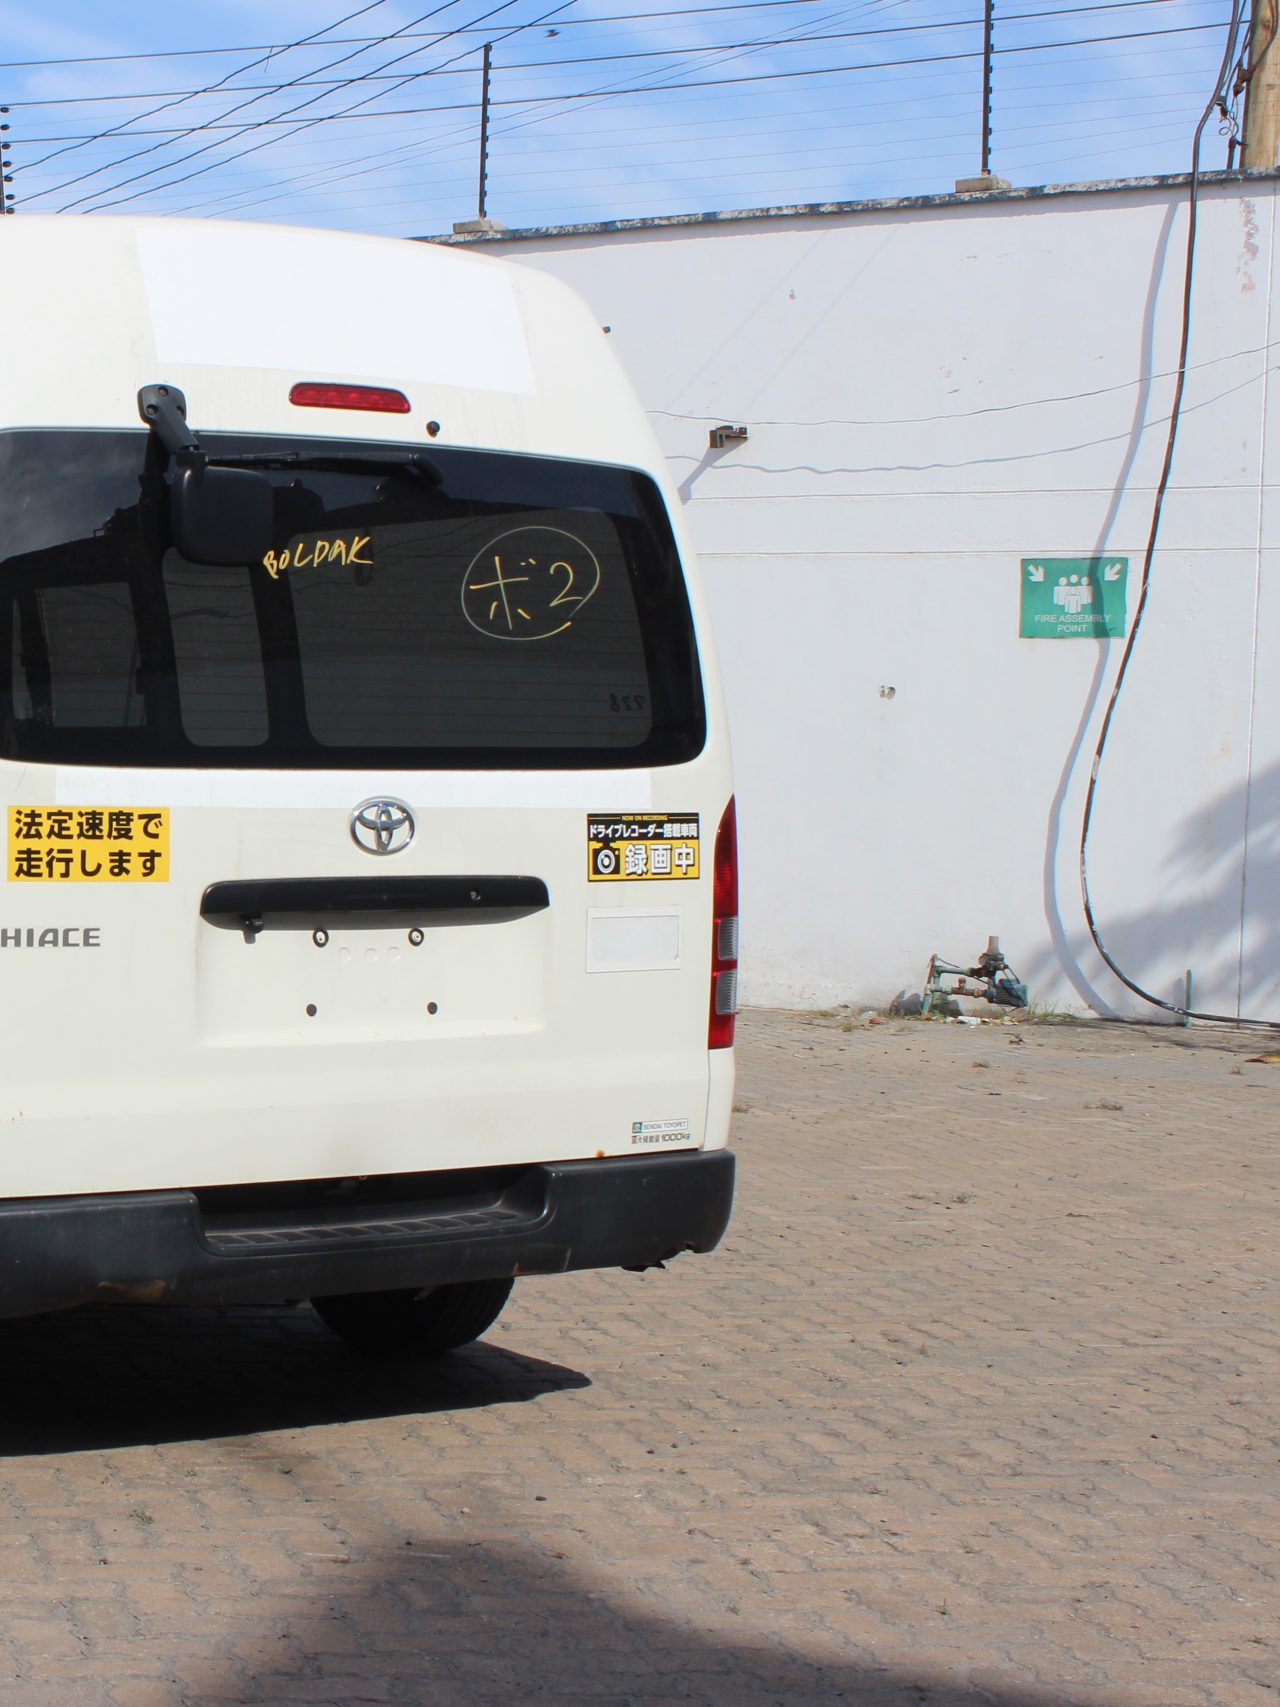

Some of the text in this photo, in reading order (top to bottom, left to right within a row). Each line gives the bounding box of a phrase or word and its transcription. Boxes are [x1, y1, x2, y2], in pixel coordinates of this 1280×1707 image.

[262, 535, 375, 579] BOLDAK
[1035, 614, 1111, 623] FIRE ASSEMBLY
[1057, 624, 1088, 632] POINT
[14, 809, 164, 840] 法定速度で
[589, 823, 698, 839] ドライブレコーダー搭載車両
[14, 847, 163, 878] 走行します
[624, 842, 695, 876] 録画中
[0, 927, 101, 948] HIACE
[664, 1121, 686, 1129] TOYOPET
